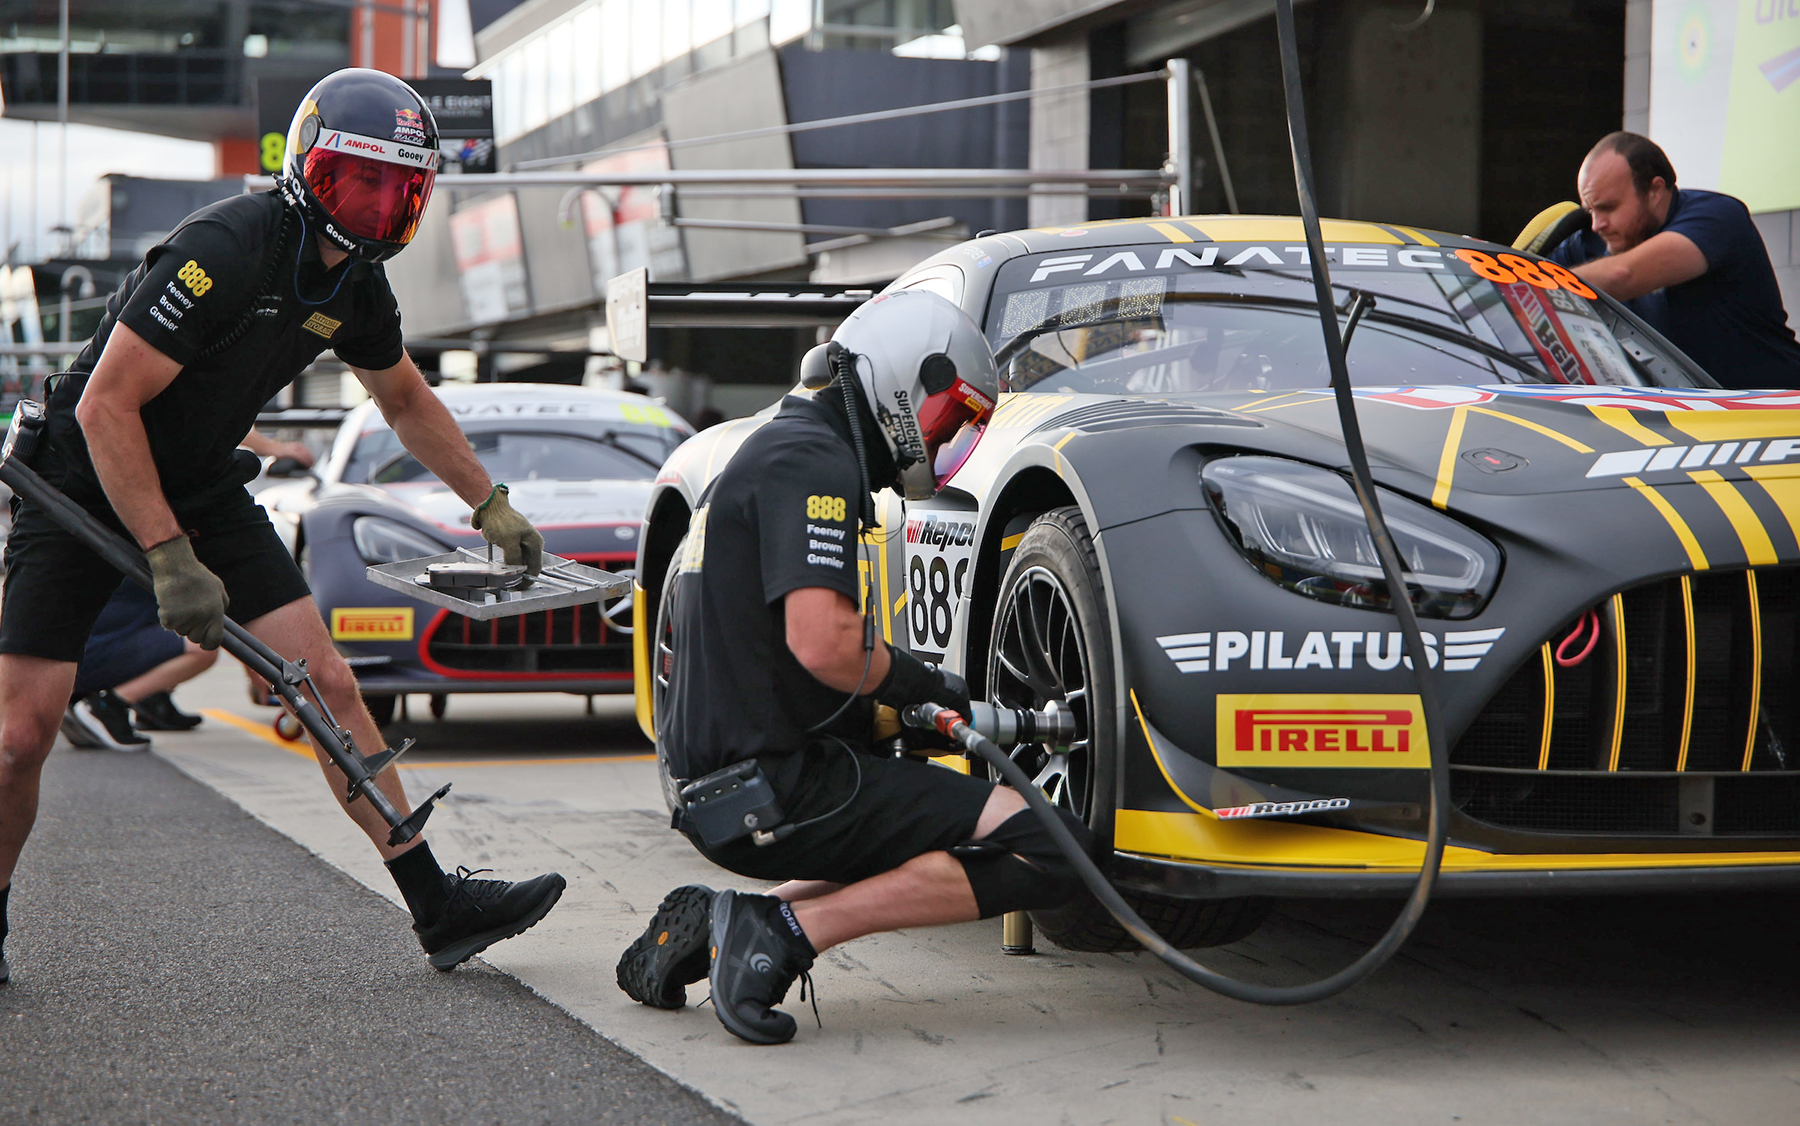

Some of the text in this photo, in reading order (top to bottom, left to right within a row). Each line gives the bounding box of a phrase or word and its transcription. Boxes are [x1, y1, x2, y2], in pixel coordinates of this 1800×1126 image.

[393, 126, 427, 139] AMPOL
[343, 139, 424, 163] AMPOL Gooey
[326, 223, 356, 250] Gooey
[177, 259, 213, 297] 888
[1030, 246, 1445, 283] FANATEC
[1454, 249, 1598, 300] 888
[159, 294, 184, 319] Brown
[166, 281, 195, 310] Feeney
[149, 305, 179, 332] Grenier
[894, 390, 927, 464] SUPERCHEAP
[806, 495, 846, 522] 888
[806, 523, 845, 541] Feeney
[808, 538, 843, 554] Brown
[806, 553, 845, 570] Grenier
[339, 614, 404, 632] PIRELLI
[1215, 631, 1439, 671] PILATUS
[1235, 709, 1413, 752] PIRELLI
[1250, 797, 1350, 816] Repco
